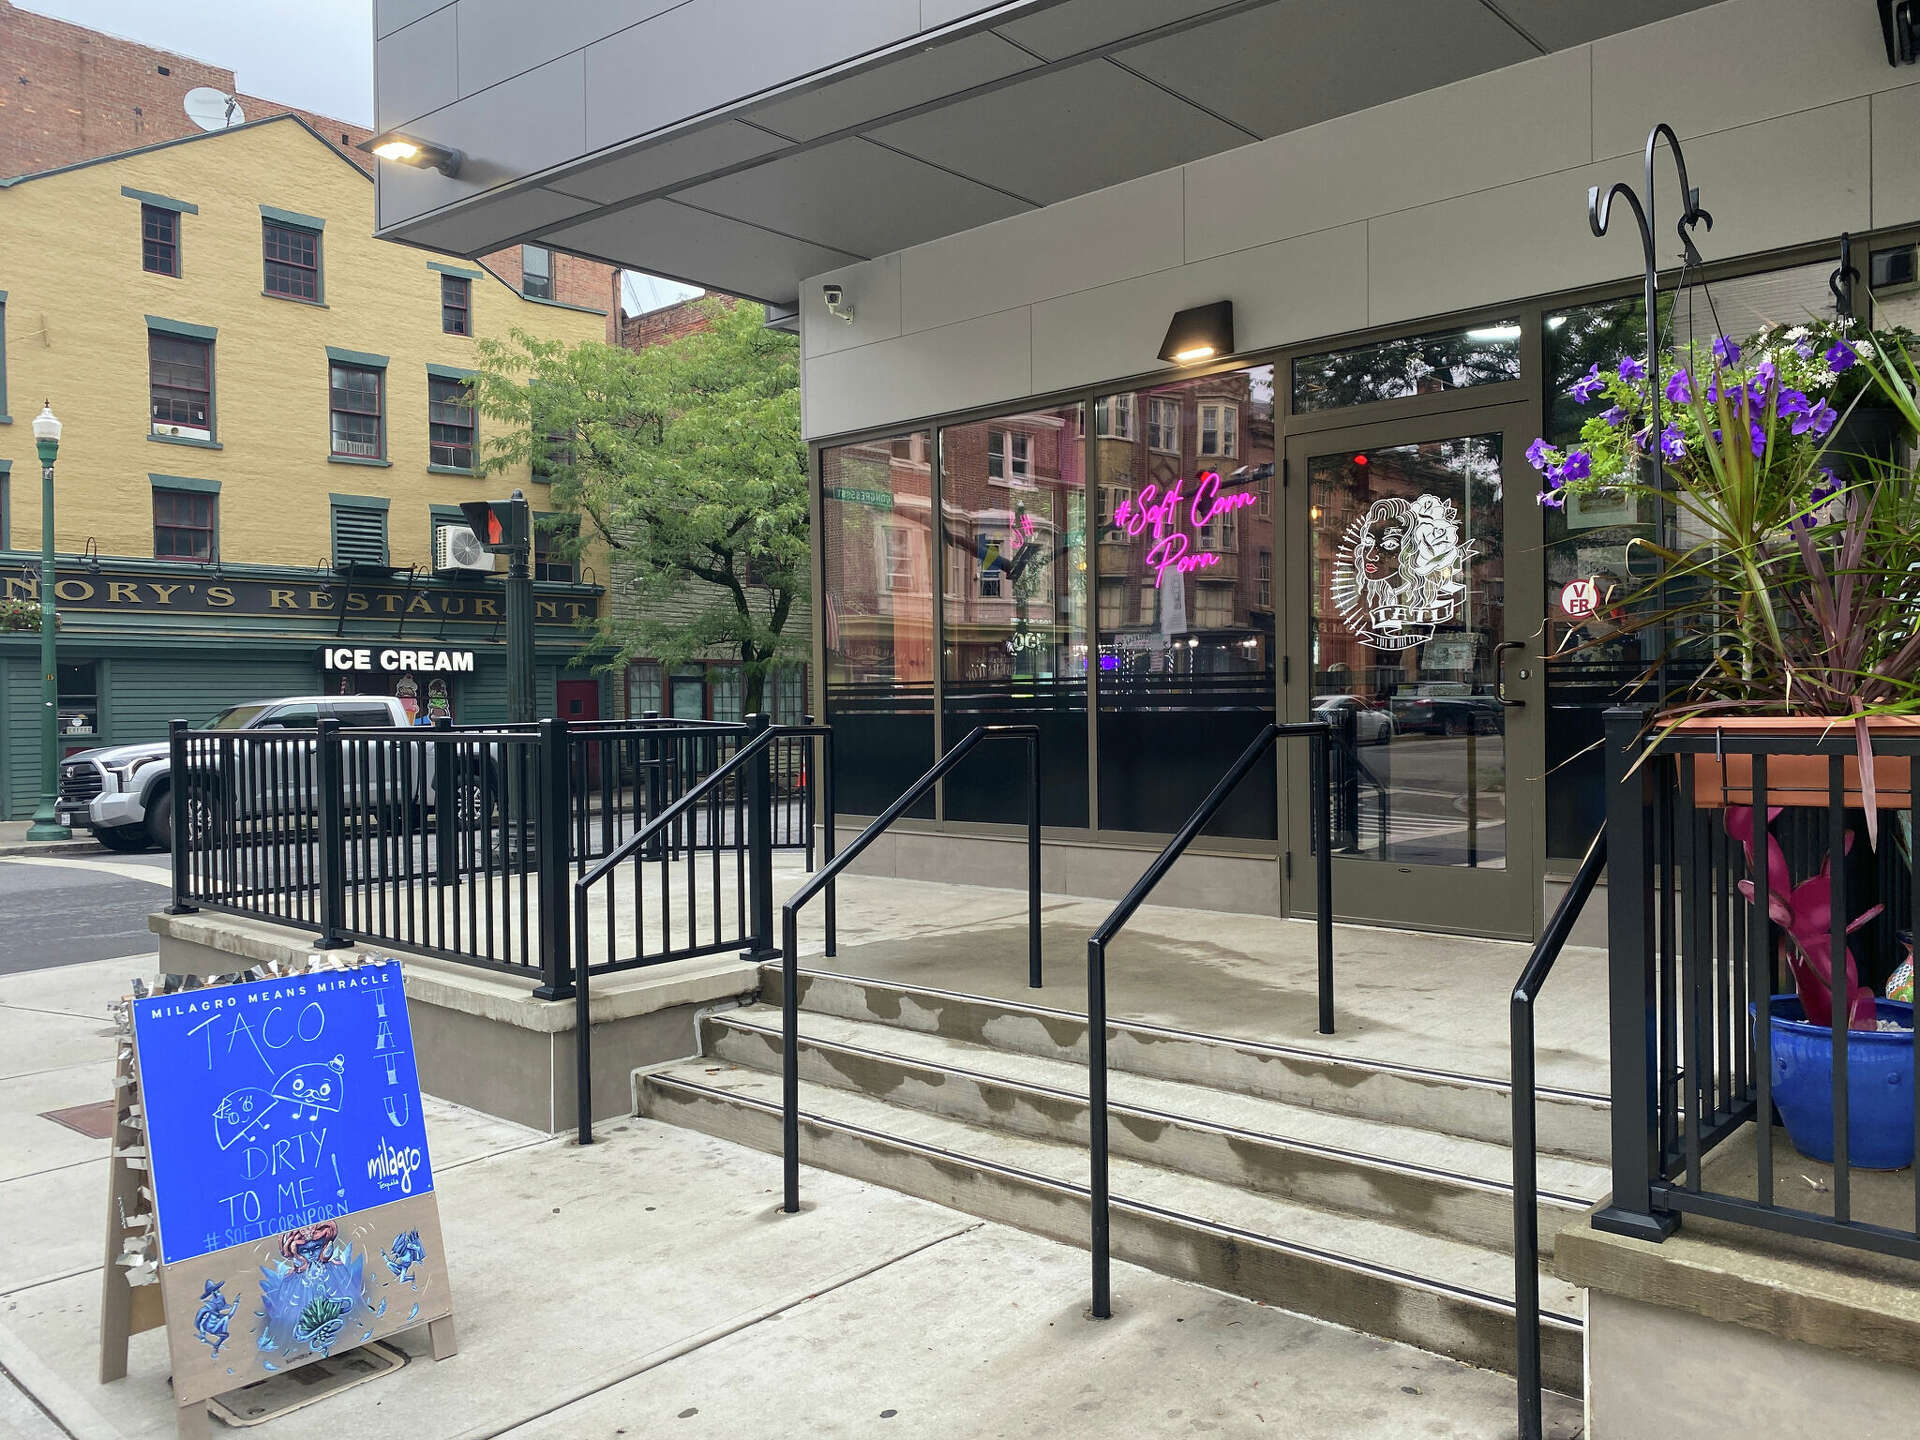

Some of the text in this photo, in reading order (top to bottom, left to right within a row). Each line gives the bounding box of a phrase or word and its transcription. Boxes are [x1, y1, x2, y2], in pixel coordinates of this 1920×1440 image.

[1114, 473, 1257, 538] #Soft Corn
[1146, 533, 1220, 589] Porn
[268, 589, 587, 619] RESTAURNT
[1373, 605, 1452, 622] TATU
[1569, 598, 1589, 612] FR
[1573, 584, 1586, 598] V
[325, 649, 474, 672] ICE CREAM
[151, 973, 390, 1019] MILAGRO MEANS MIRACLE
[187, 1001, 326, 1075] TACO
[240, 1128, 327, 1180] DIRTY
[367, 1136, 421, 1193] milagro
[203, 1200, 349, 1251] #SOFTCORNPORN
[218, 1190, 261, 1227] TO
